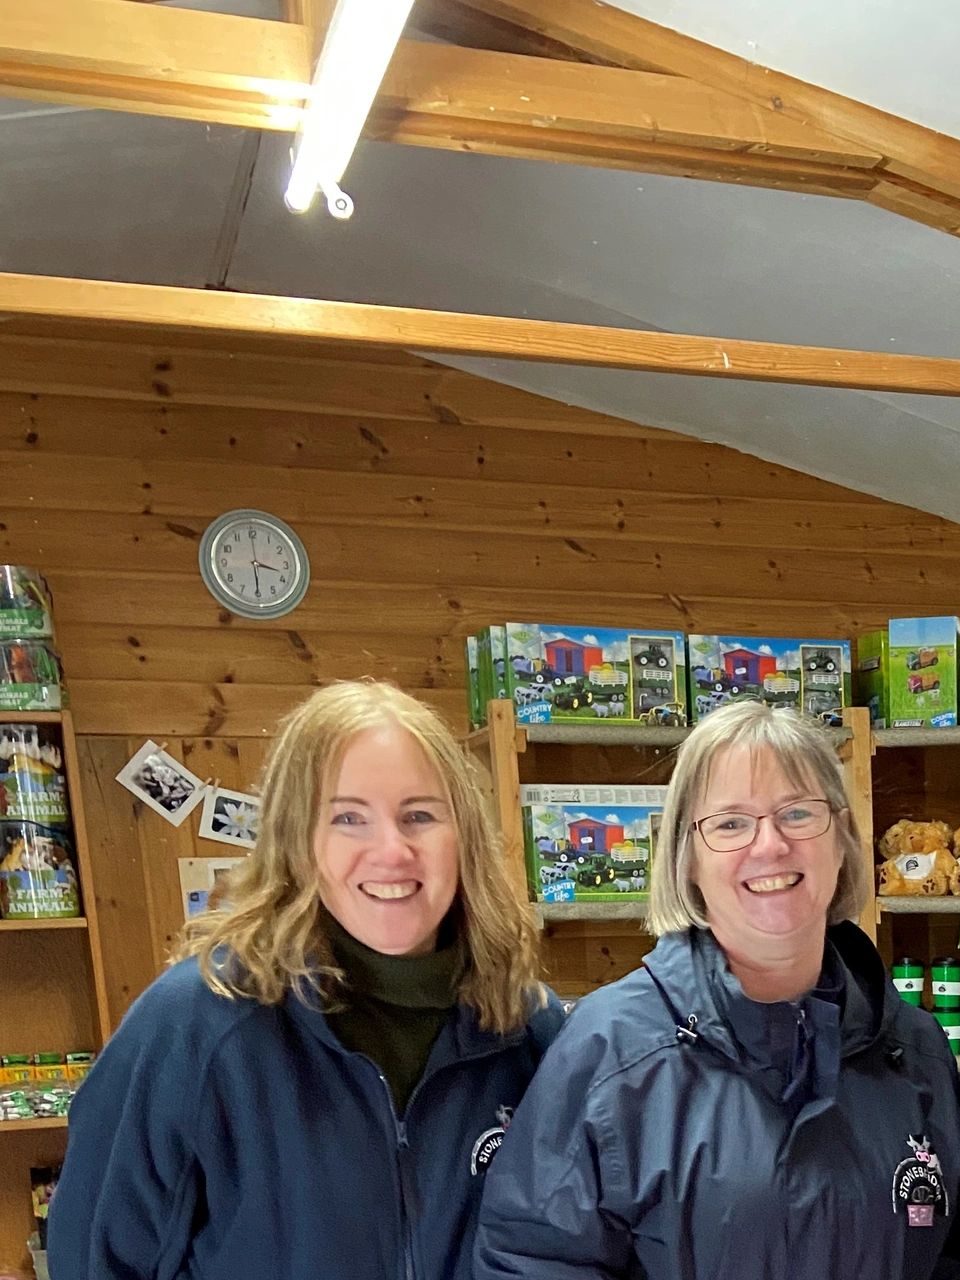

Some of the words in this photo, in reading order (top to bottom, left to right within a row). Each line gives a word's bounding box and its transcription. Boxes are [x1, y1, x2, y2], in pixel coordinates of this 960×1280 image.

[517, 703, 553, 718] COUNTRY
[17, 791, 61, 802] FARM
[16, 889, 64, 899] FARM
[542, 881, 576, 896] COUNTRY
[9, 901, 74, 913] ANIMALS
